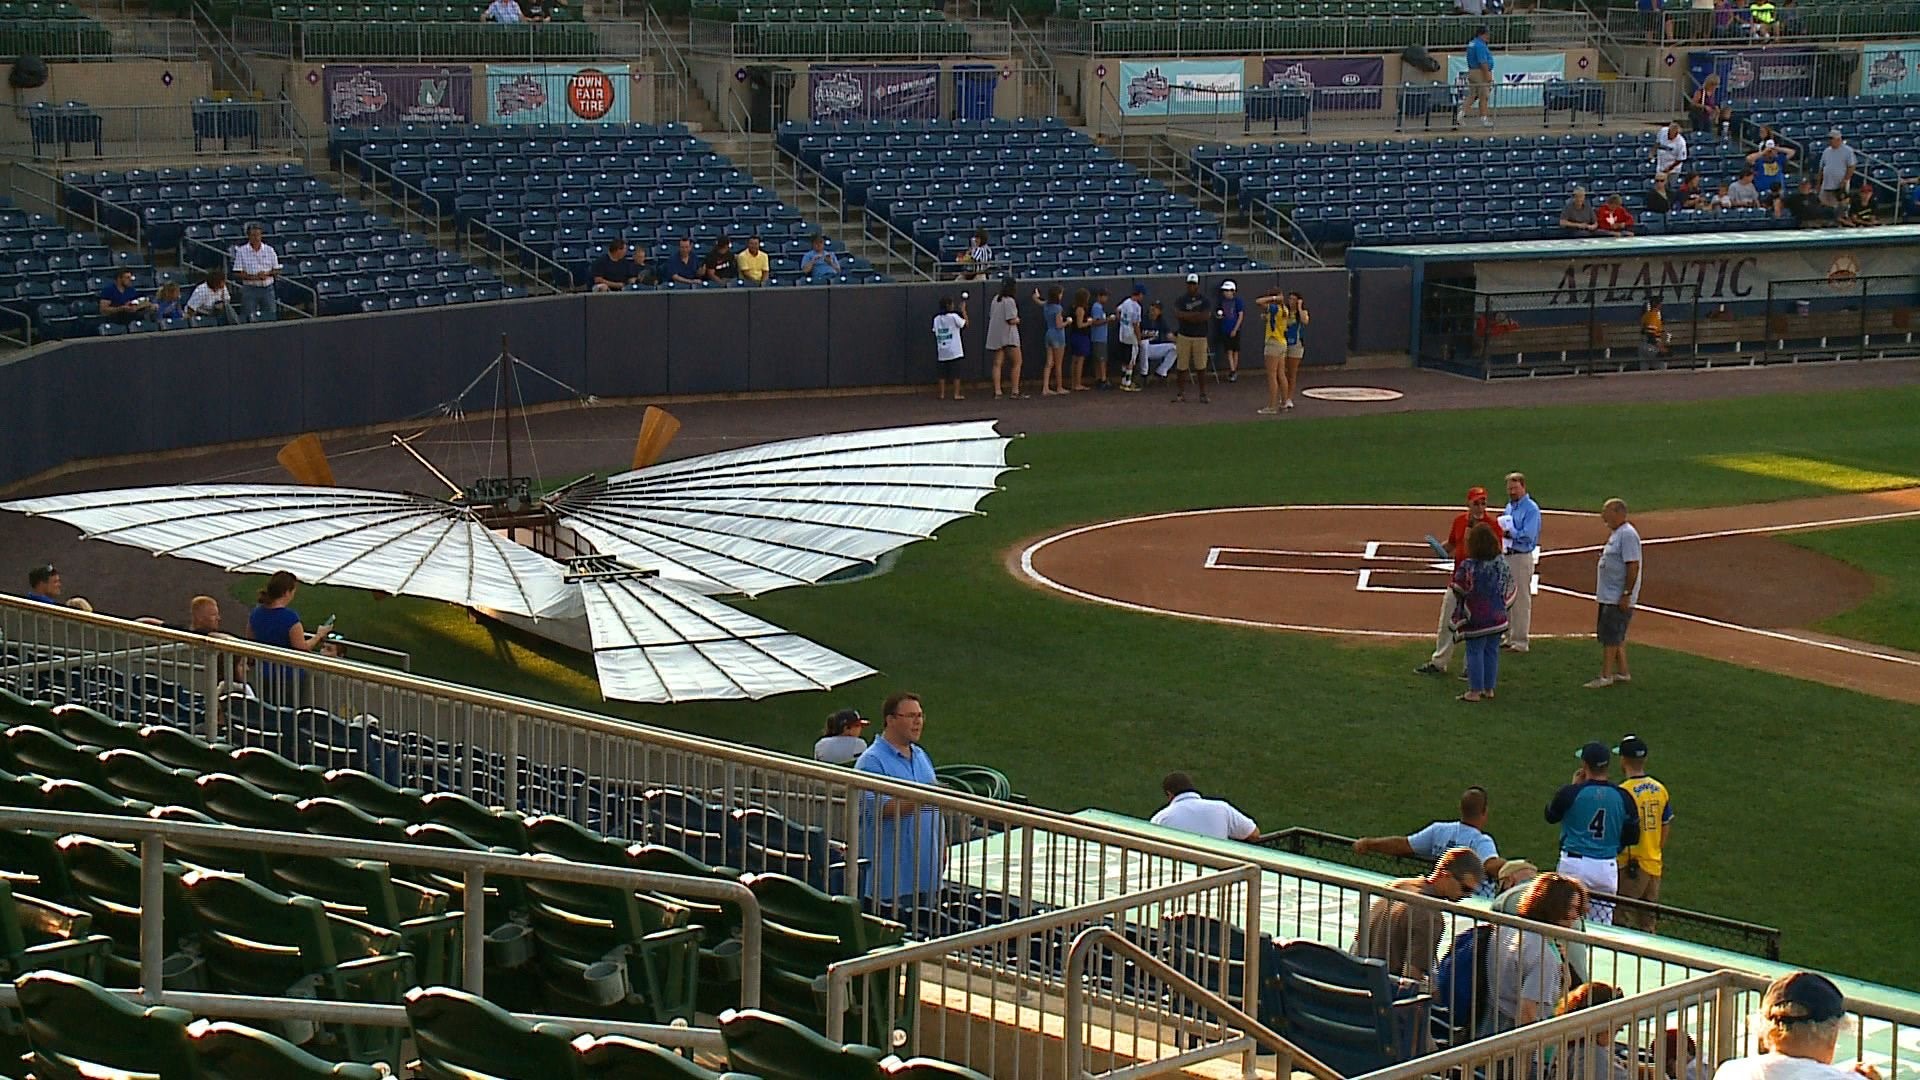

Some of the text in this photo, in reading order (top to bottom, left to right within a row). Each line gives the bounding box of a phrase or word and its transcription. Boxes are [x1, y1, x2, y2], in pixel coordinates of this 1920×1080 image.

[572, 76, 602, 87] TOWN
[576, 88, 603, 99] FAIR
[580, 100, 604, 111] TIRE
[1550, 258, 1757, 304] ATLANTIC
[1588, 808, 1606, 840] 4
[1639, 800, 1660, 832] 15
